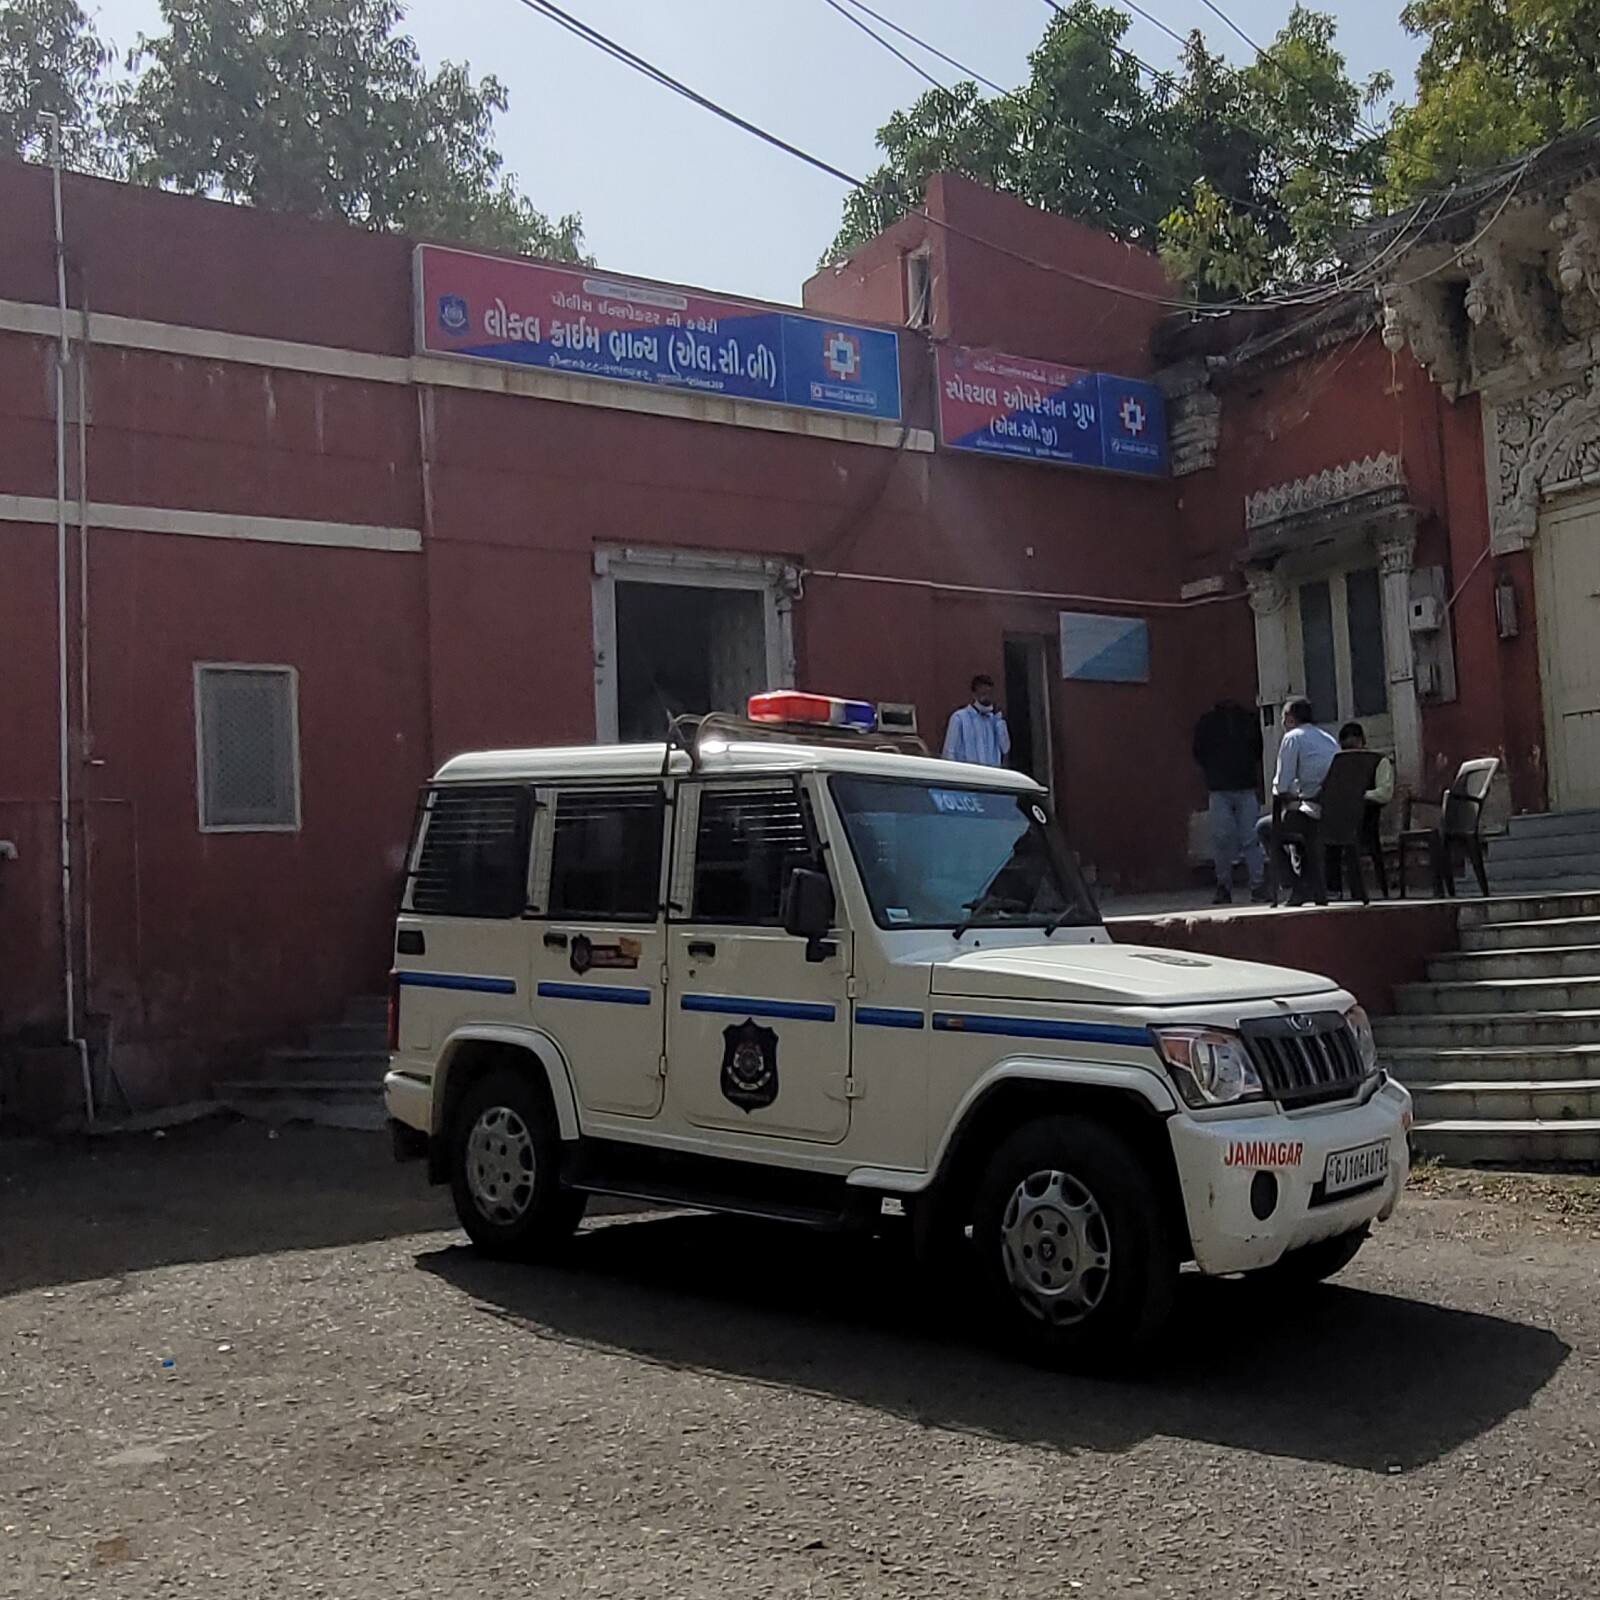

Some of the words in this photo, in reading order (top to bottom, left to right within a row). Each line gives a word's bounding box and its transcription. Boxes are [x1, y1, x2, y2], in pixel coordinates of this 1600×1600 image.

[484, 297, 540, 344] લોકલ
[1003, 385, 1067, 418] ઓપરેશન
[1224, 1140, 1303, 1167] JAMNAGAR
